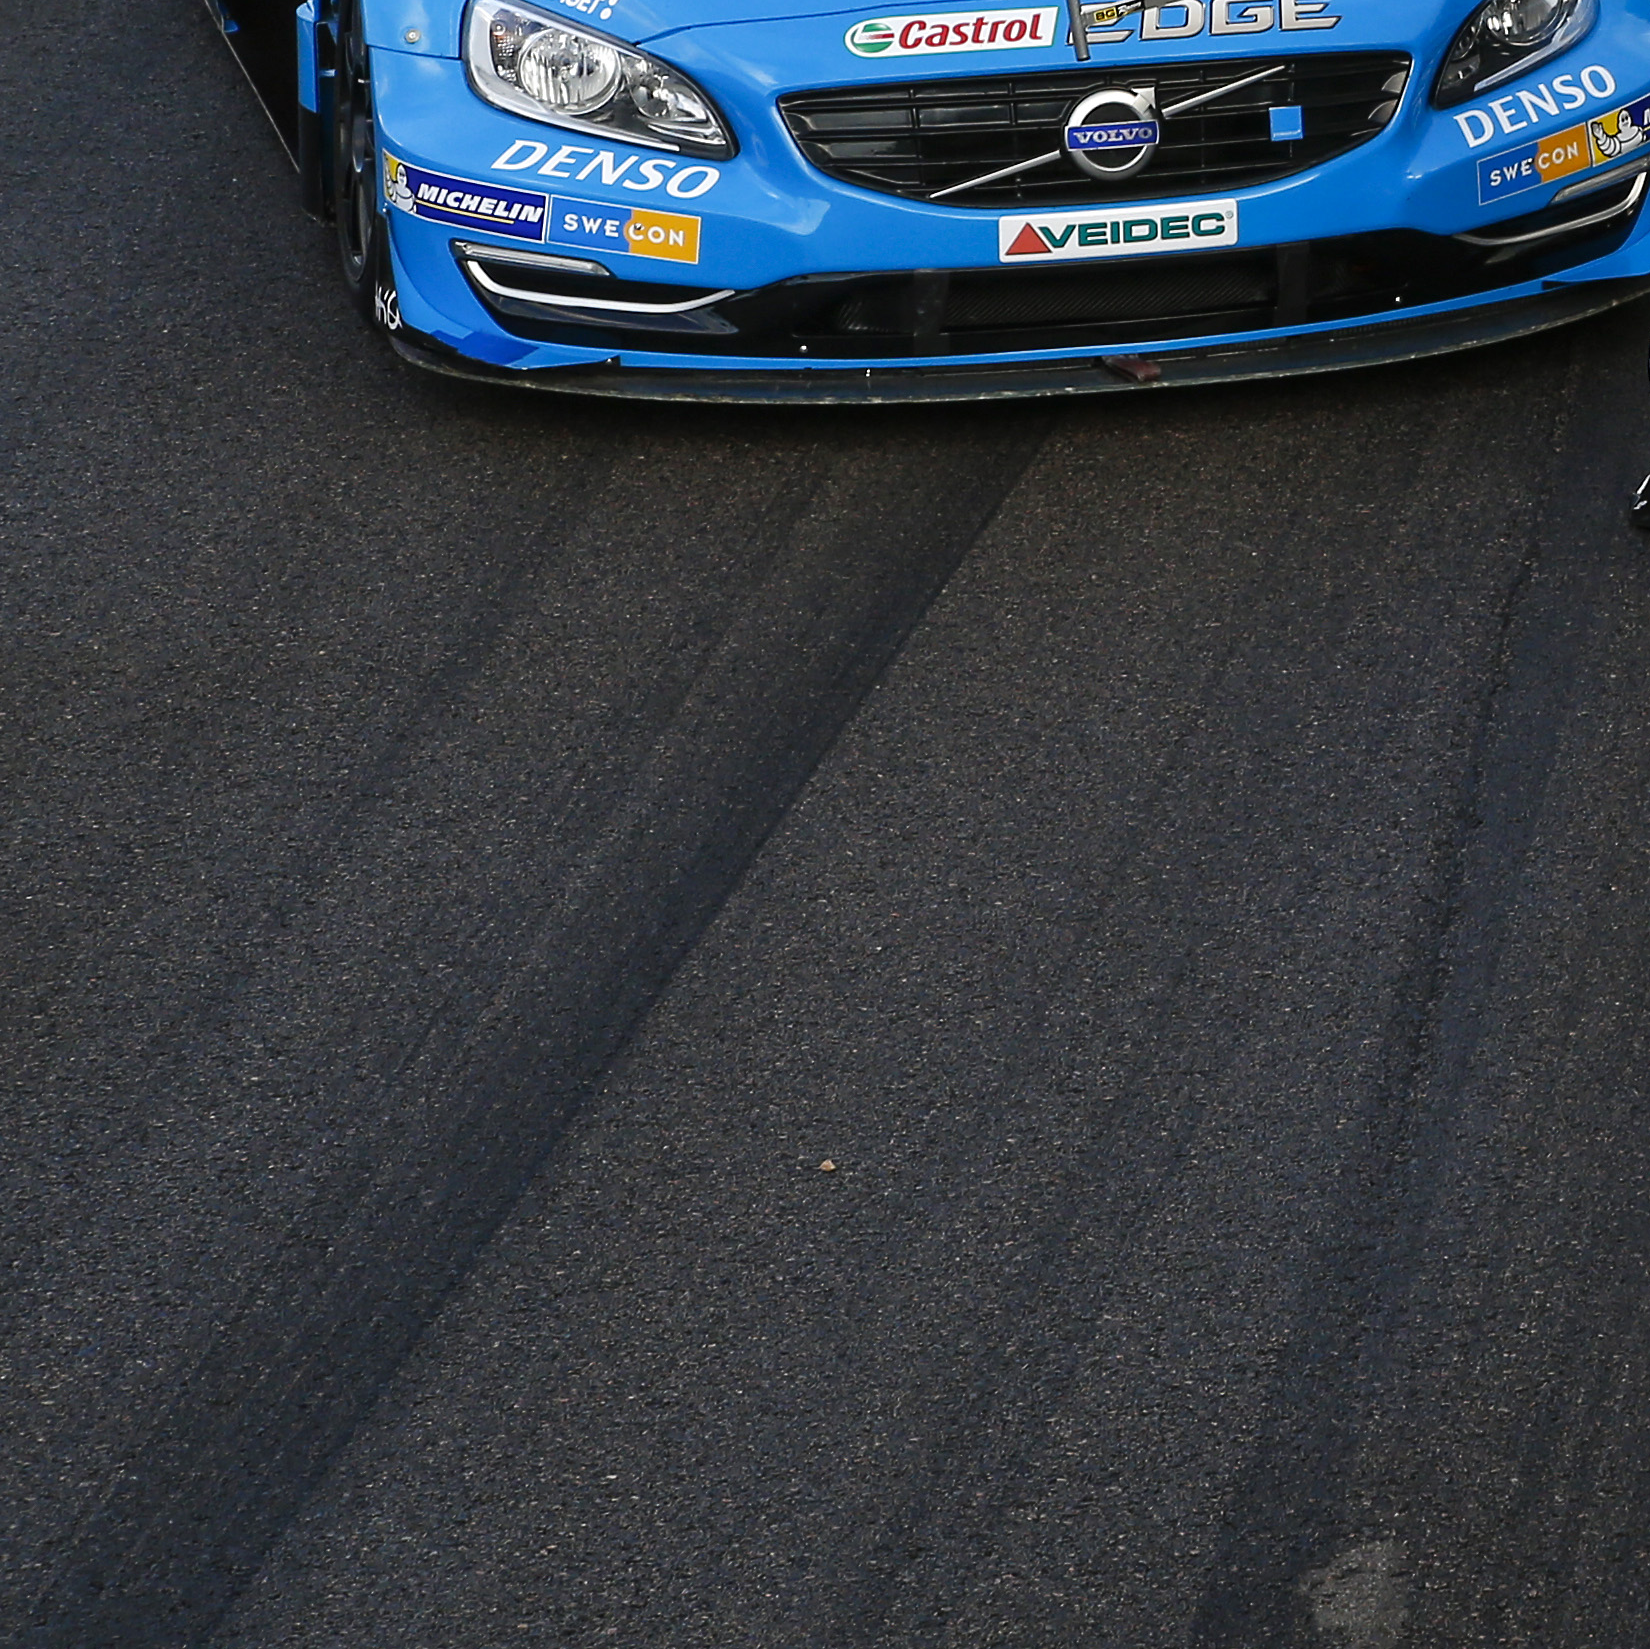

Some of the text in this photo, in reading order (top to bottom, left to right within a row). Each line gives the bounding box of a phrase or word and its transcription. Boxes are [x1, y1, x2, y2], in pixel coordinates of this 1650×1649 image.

[899, 13, 1044, 49] Castrol
[1453, 64, 1617, 149] DENSO
[1072, 124, 1154, 147] VOLVO
[491, 139, 721, 200] DENSO
[415, 183, 544, 223] MICHELIN
[1039, 212, 1227, 249] VEIDEC
